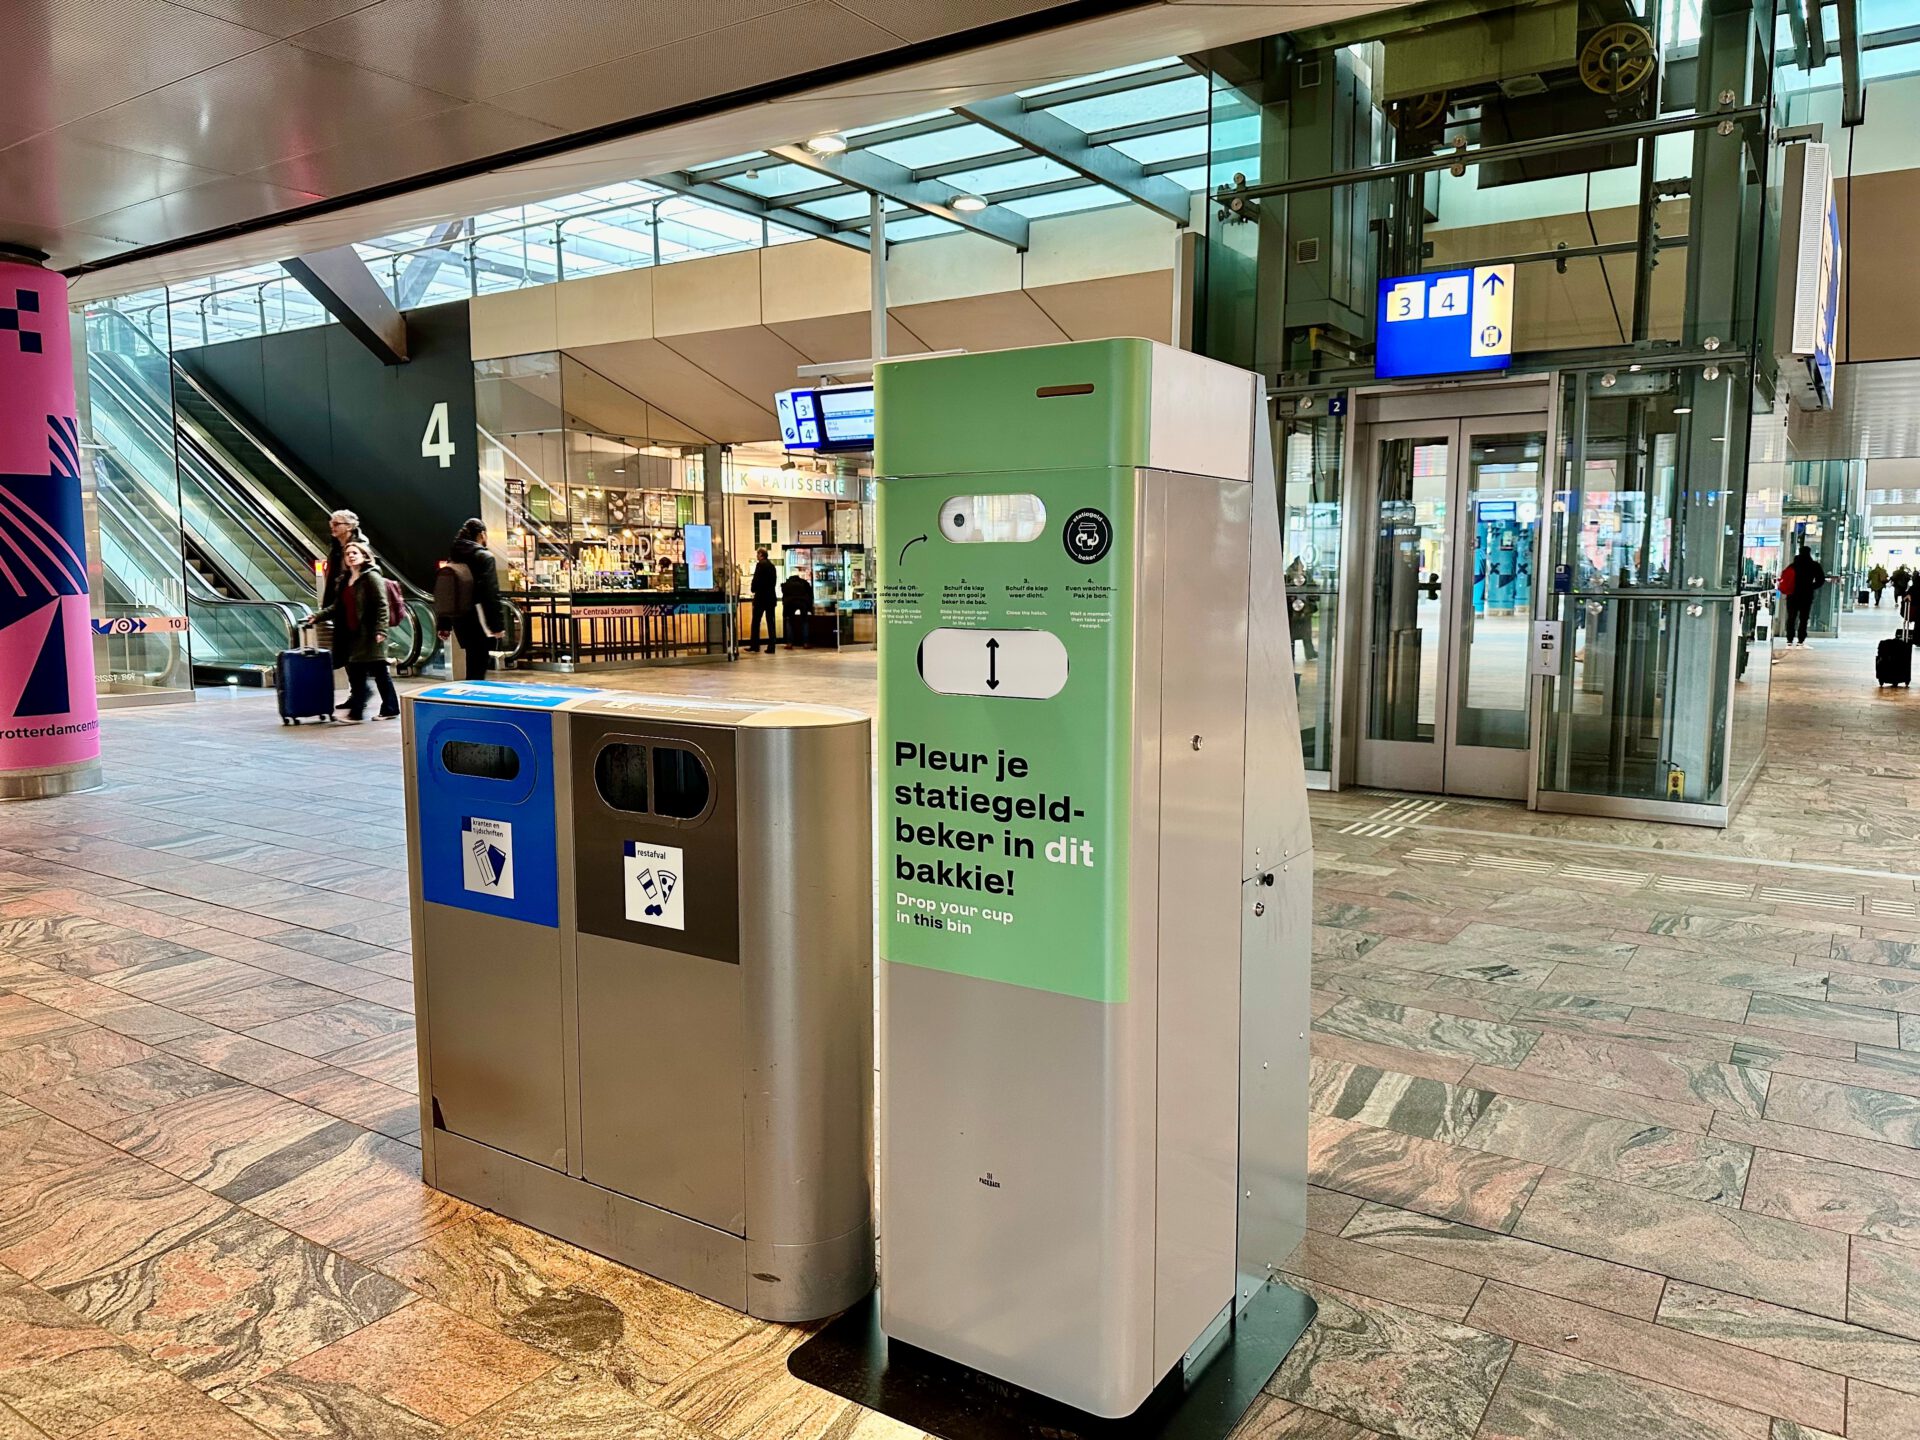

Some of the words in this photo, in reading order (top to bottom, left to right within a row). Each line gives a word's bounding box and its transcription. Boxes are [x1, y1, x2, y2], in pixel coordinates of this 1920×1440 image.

[1398, 297, 1411, 317] 3
[1441, 292, 1455, 311] 4
[1333, 401, 1341, 413] 2
[421, 402, 456, 468] 4
[762, 474, 845, 495] PATISSERIE
[1073, 512, 1103, 522] statiegeld
[1077, 553, 1097, 561] beker
[583, 607, 610, 616] Centraal
[610, 606, 633, 615] Station
[168, 619, 181, 629] 10
[895, 741, 989, 774] Pleur
[995, 749, 1029, 782] je
[895, 782, 1085, 823] statiegeld-
[472, 819, 493, 828] kranten
[472, 826, 504, 838] tijdschriften
[895, 816, 995, 853] beker
[1004, 829, 1035, 859] in
[1044, 835, 1094, 868] dit
[637, 848, 667, 860] restafval
[895, 854, 1014, 896] bakkie!
[896, 892, 937, 912] Drop
[939, 901, 978, 917] your
[981, 908, 1014, 926] cup
[896, 910, 910, 924] in
[913, 912, 944, 929] this
[946, 918, 972, 935] bin
